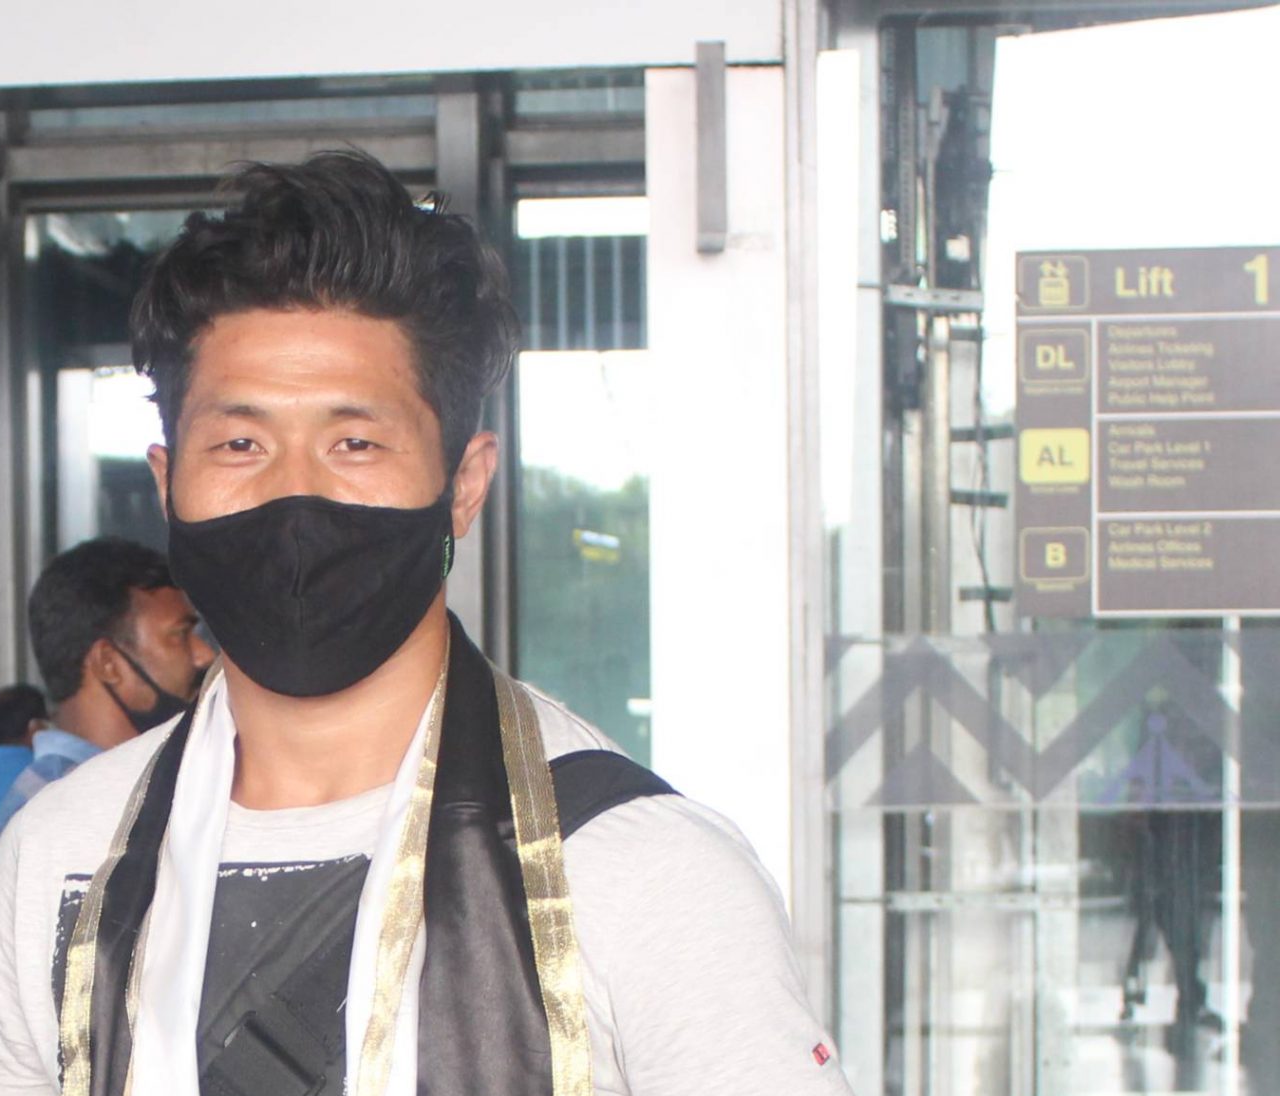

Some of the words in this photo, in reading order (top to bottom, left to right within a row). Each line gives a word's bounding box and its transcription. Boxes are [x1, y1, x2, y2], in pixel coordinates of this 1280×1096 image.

[1115, 266, 1174, 297] Lift
[1244, 254, 1269, 304] 1
[1036, 344, 1075, 370] DL
[1037, 445, 1073, 467] AL
[1045, 542, 1066, 568] B
